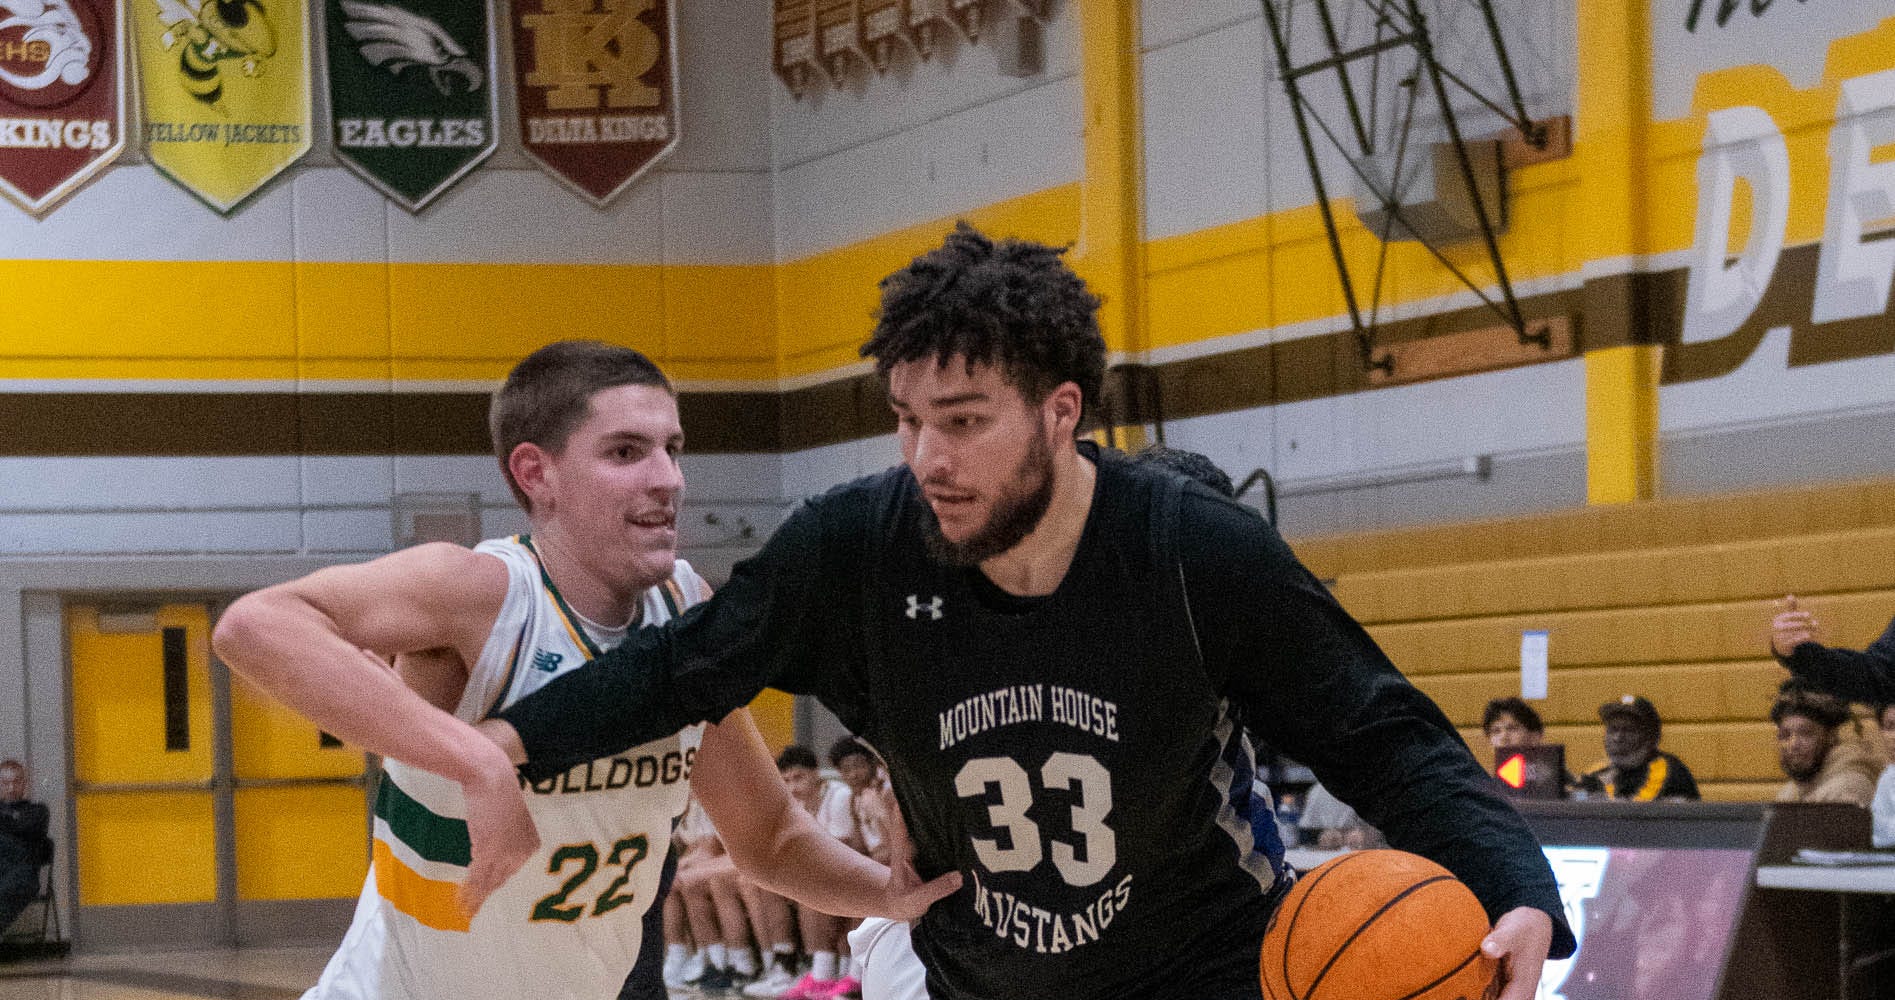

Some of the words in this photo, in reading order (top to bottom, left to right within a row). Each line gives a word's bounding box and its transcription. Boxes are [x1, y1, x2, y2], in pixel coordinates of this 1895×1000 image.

[148, 122, 220, 143] YELLOW
[223, 123, 301, 147] JACKETS
[339, 118, 485, 148] EAGLES
[528, 117, 599, 143] DELTA
[600, 115, 668, 141] KINGS
[939, 684, 1043, 750] MOUNTAIN
[1051, 685, 1119, 742] HOUSE
[954, 751, 1117, 887] 33
[528, 832, 649, 924] 22
[971, 869, 1133, 953] MUSTANGS
